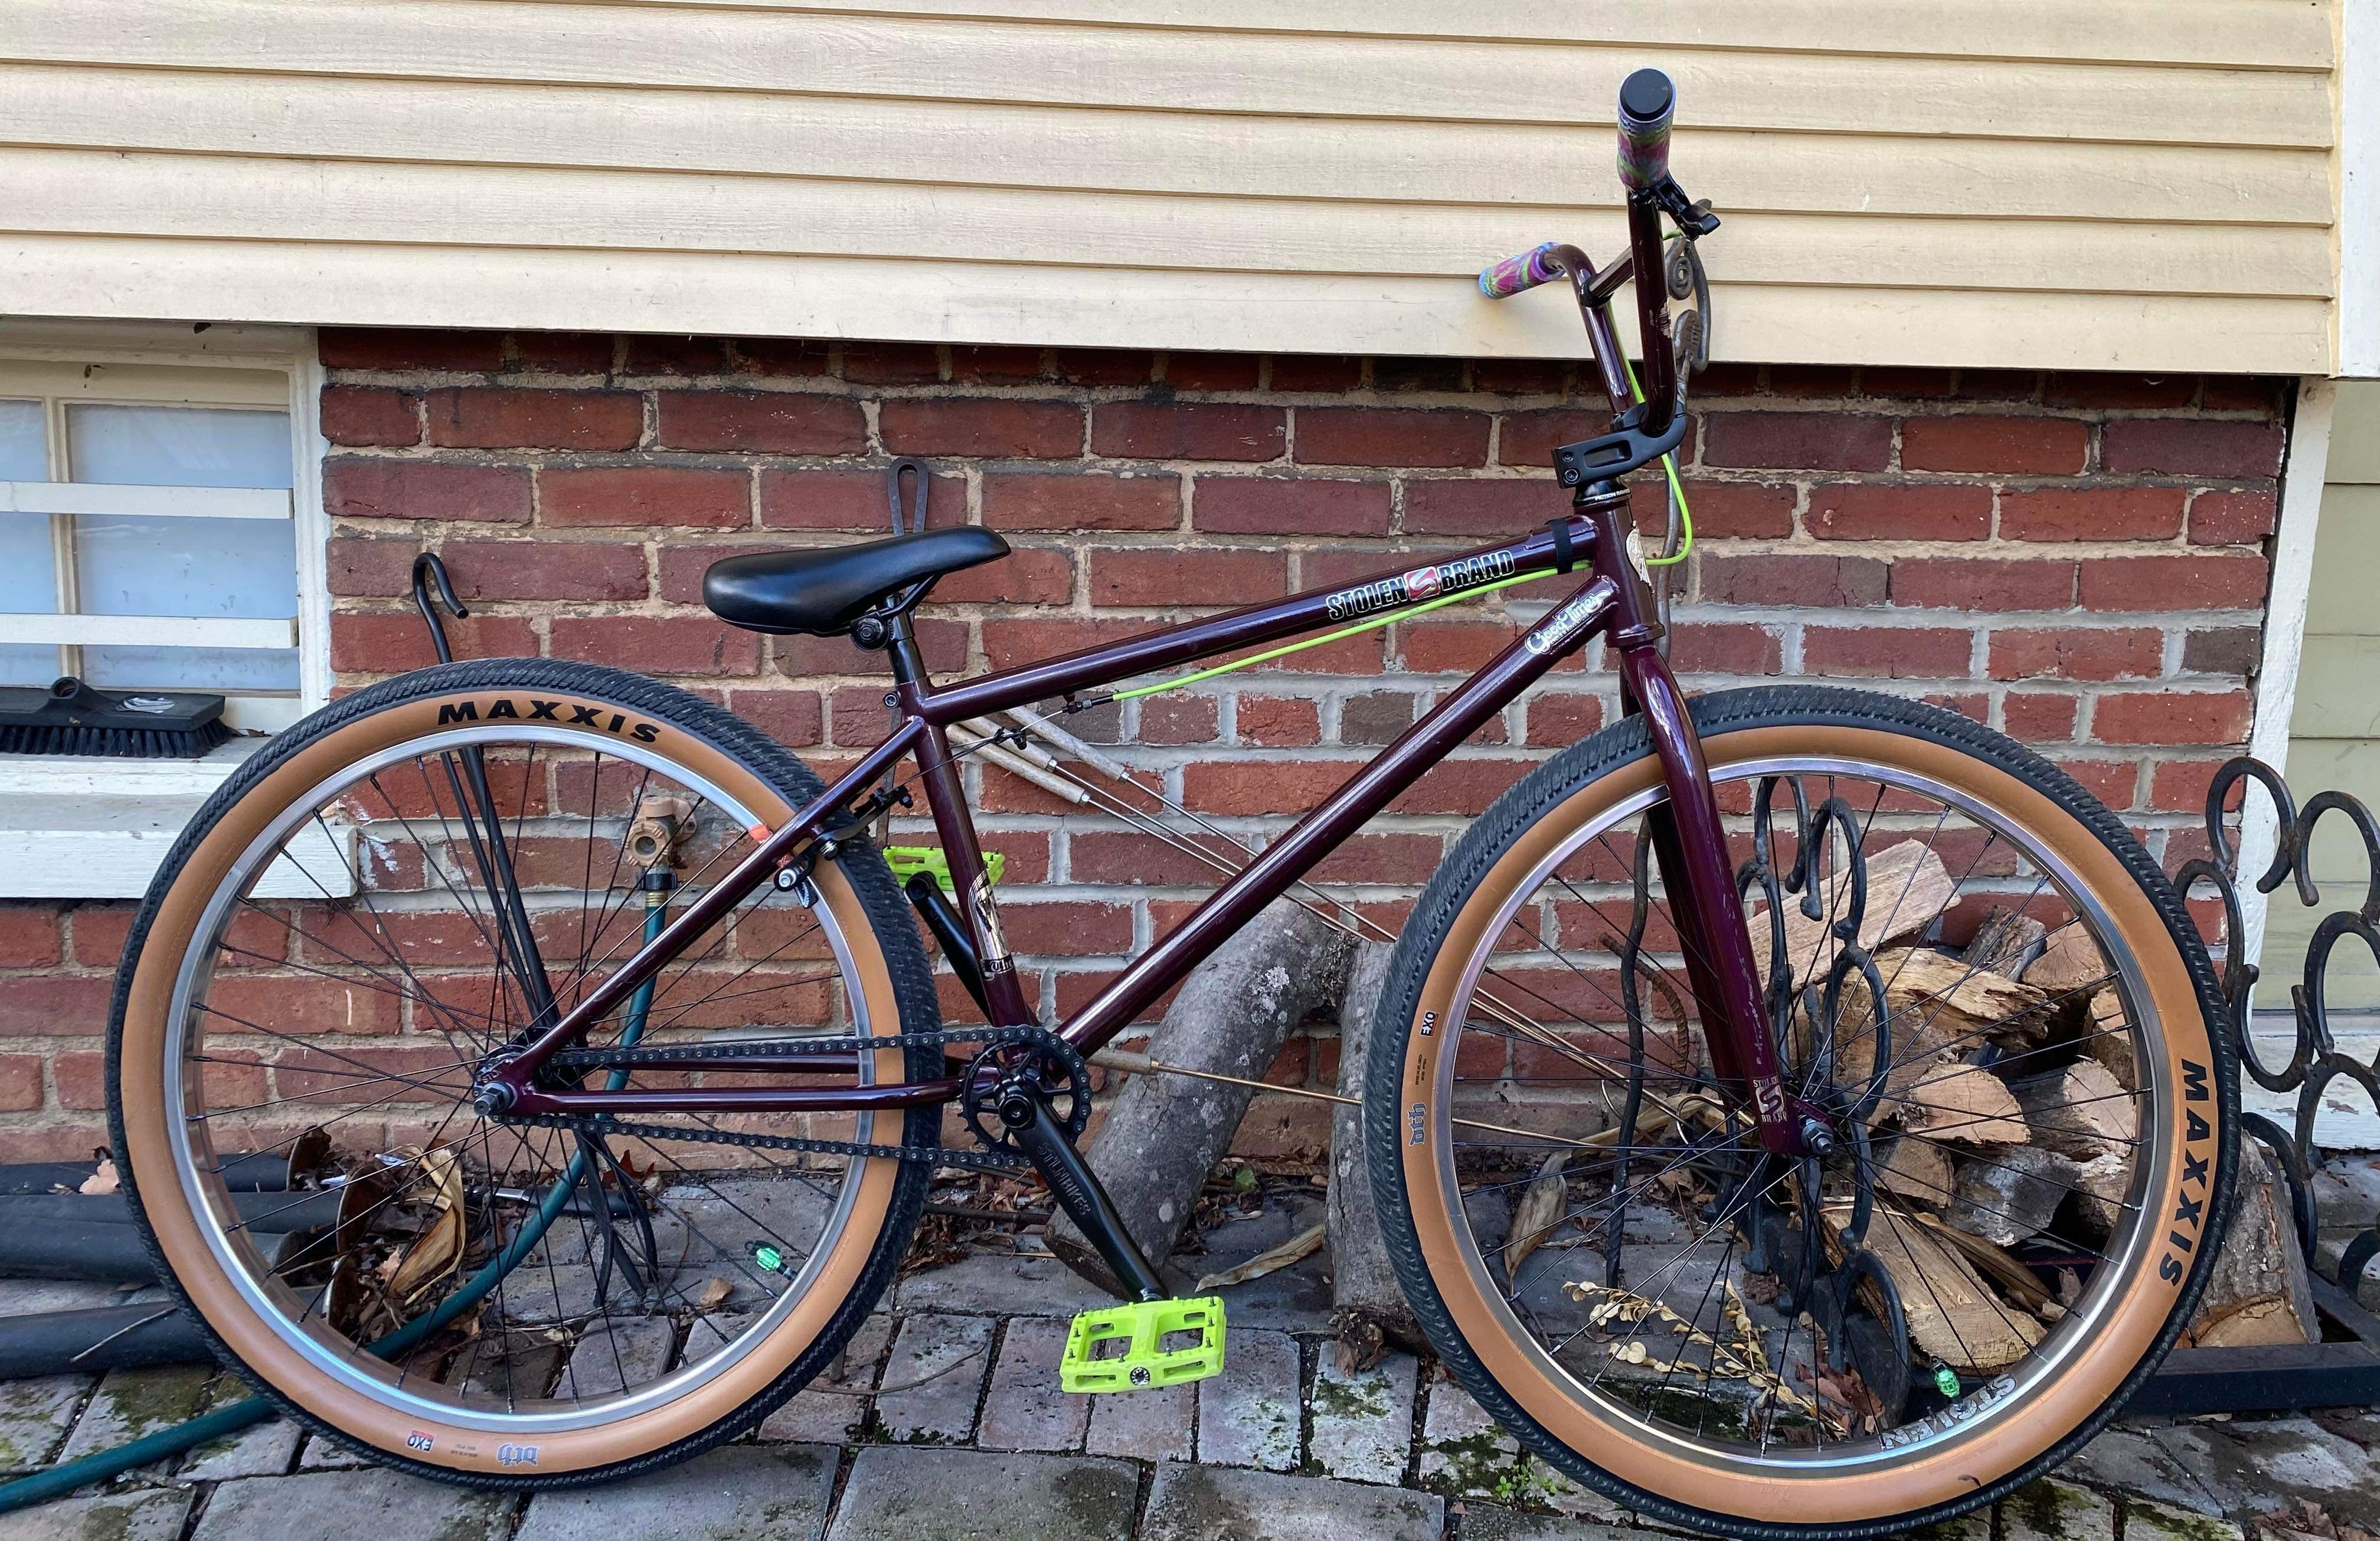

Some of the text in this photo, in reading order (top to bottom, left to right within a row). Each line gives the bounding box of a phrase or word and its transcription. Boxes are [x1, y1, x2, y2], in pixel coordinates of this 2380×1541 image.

[1326, 576, 1407, 621] STOLEN
[1440, 550, 1515, 591] BRAND
[438, 700, 661, 743] MAXXIS
[1421, 1011, 1435, 1036] EXO
[1753, 1076, 1779, 1088] STOLEN
[1761, 1111, 1788, 1123] BRAND
[1038, 1143, 1091, 1216] STLNBIKES
[2160, 1058, 2210, 1287] MAXXIS
[407, 1435, 431, 1452] EXO
